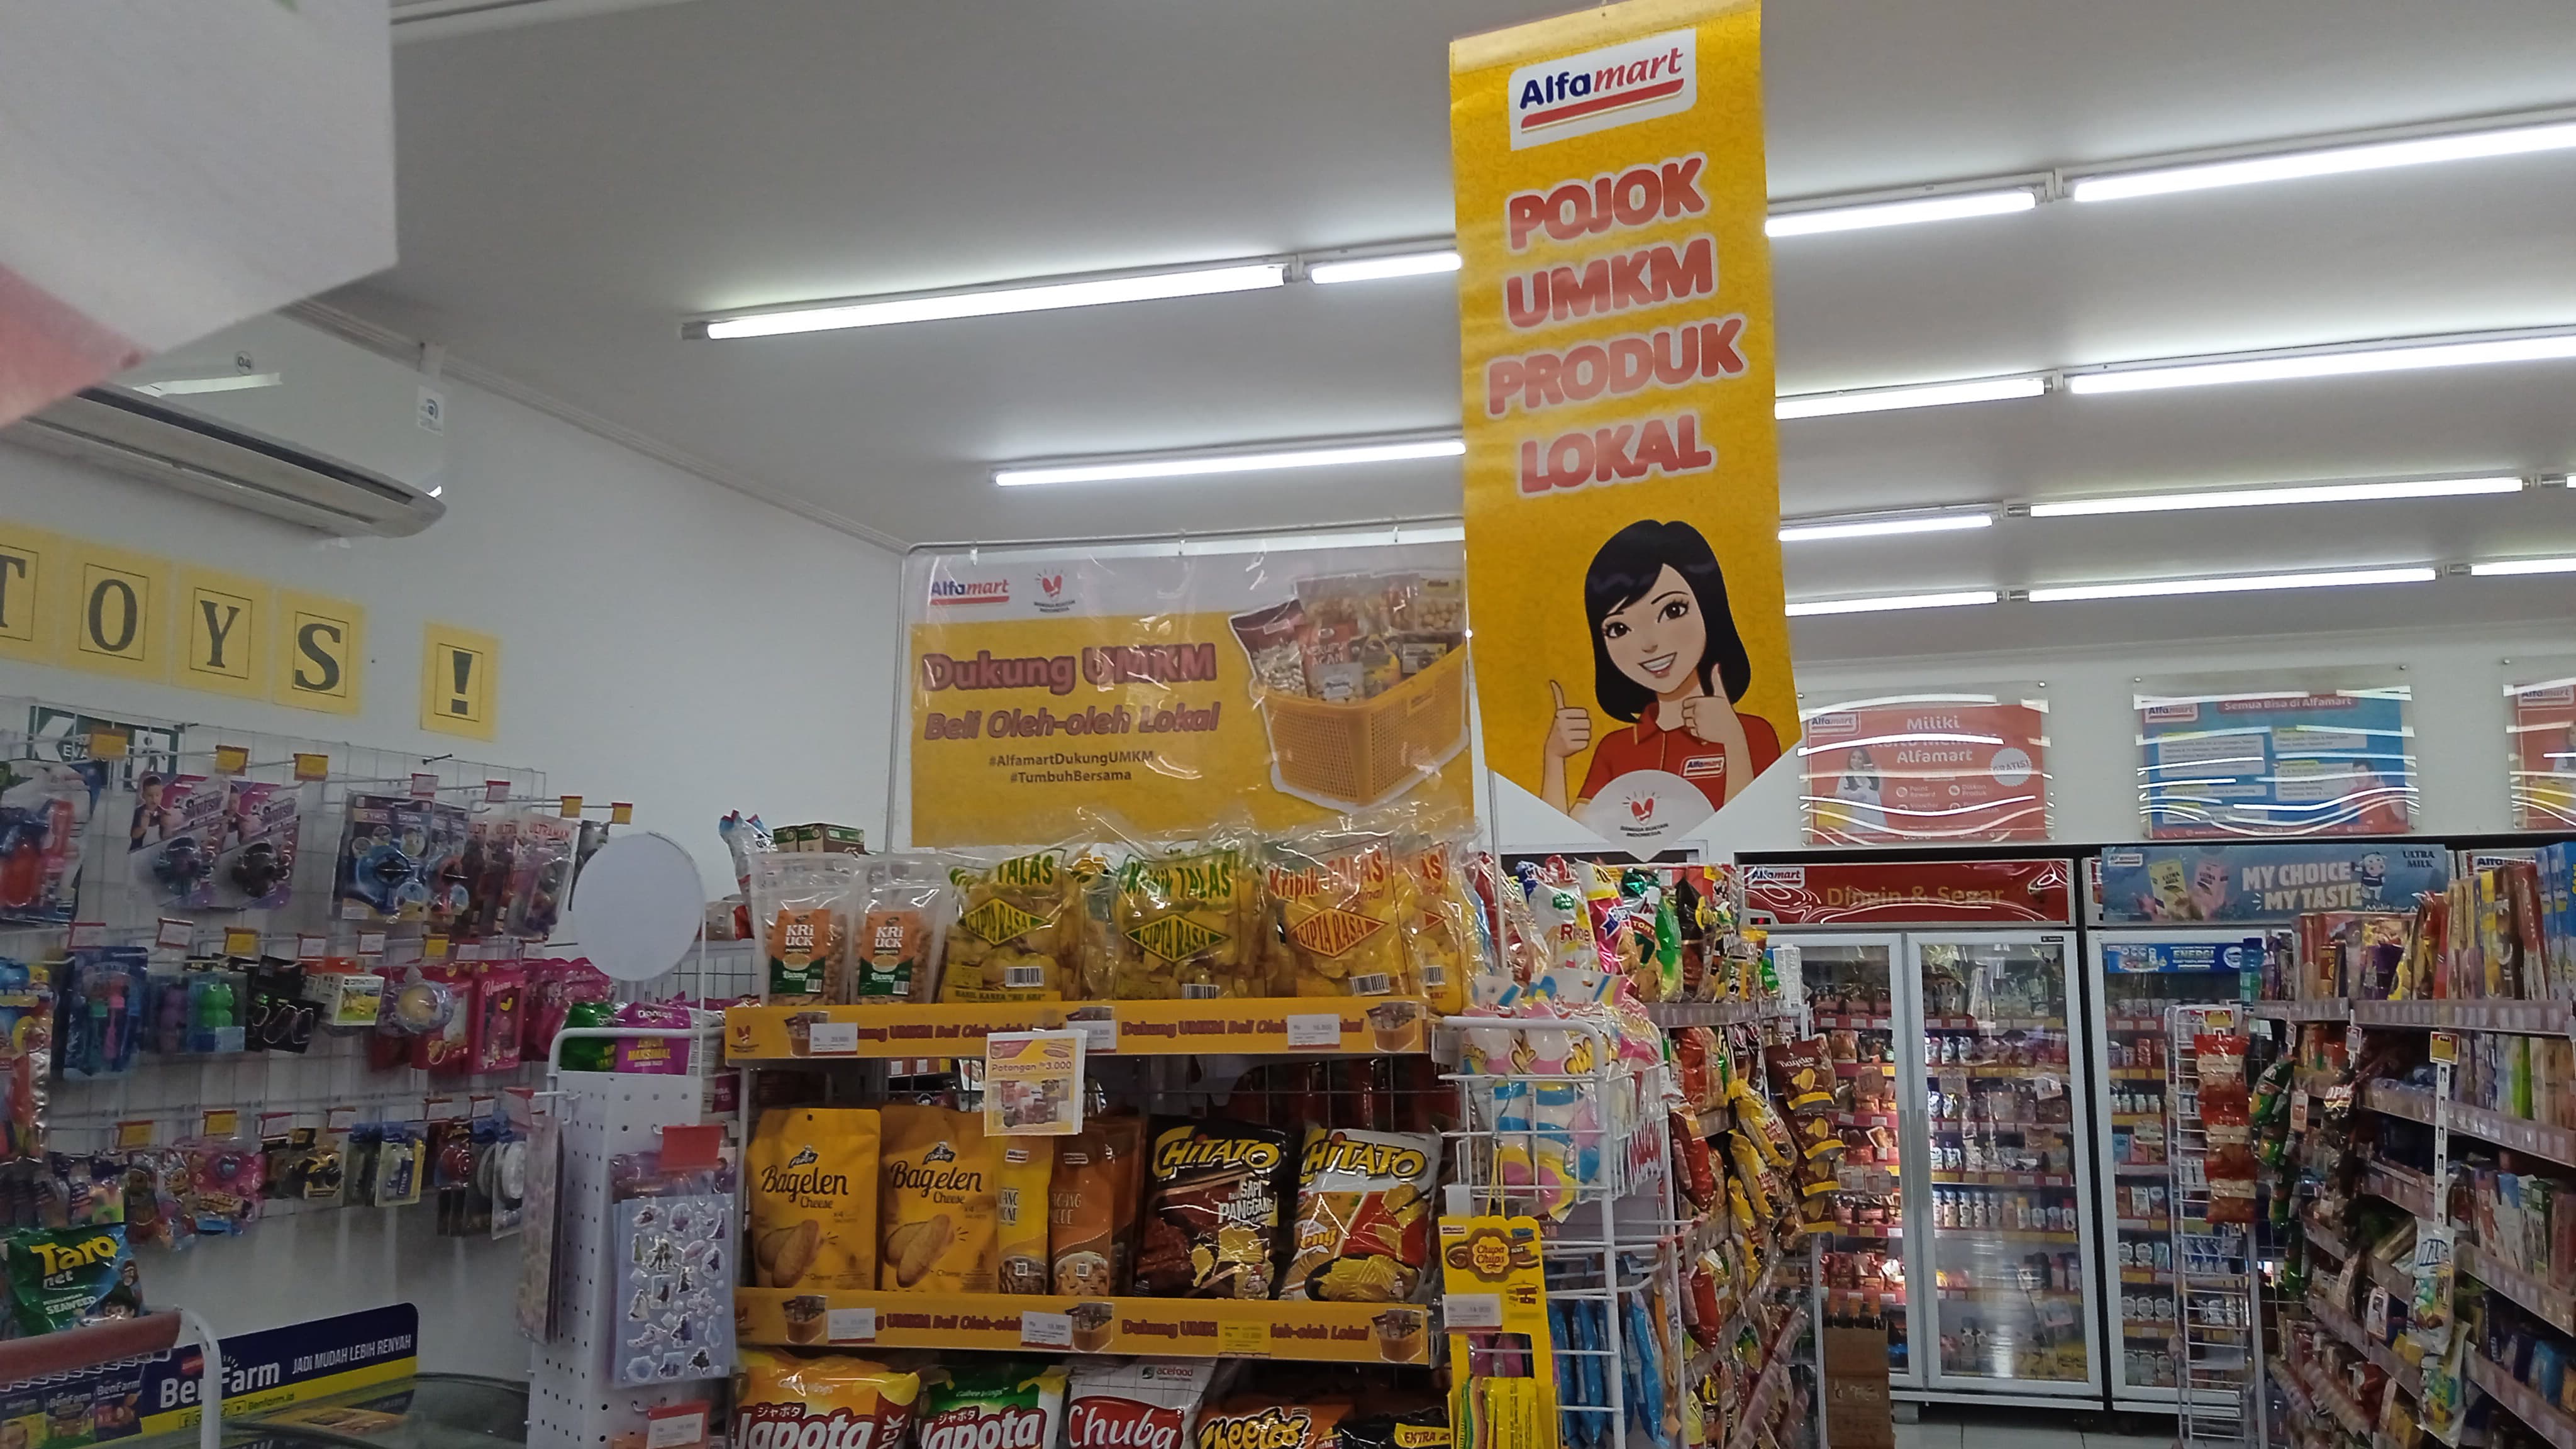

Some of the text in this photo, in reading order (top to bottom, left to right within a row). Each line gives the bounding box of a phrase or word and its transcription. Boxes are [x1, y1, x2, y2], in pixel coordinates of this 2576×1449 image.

[1519, 47, 1684, 109] Alfamart
[1508, 157, 1707, 250] POJOK
[1506, 239, 1714, 328] UMKM
[1487, 319, 1745, 415] PRODUK
[1520, 414, 1713, 494] LOKAL
[931, 579, 1009, 596] Alfamart
[922, 643, 1217, 696] Dukung UMKM
[2224, 696, 2353, 711] Semua Bisa di Alfamart
[924, 701, 1221, 740] Beli Oleh-oleh Lokal
[1811, 716, 1853, 726] Alfamart
[1907, 716, 1960, 730] Miliki
[989, 751, 1154, 767] #AlfamartDukungUMKM
[1896, 750, 1974, 764] Alfamart
[1011, 770, 1132, 784] #TumbuhBersama
[2402, 850, 2435, 860] ULTRA
[2407, 858, 2433, 868] MILK
[997, 854, 1054, 886] TALAS
[1175, 862, 1232, 899] TALAS
[2242, 862, 2352, 891] MY CHOICE
[1269, 867, 1320, 903] Kripik
[2264, 883, 2363, 911] MY TASTE
[1175, 917, 1206, 957] RASA
[1298, 913, 1366, 953] CIPTA RASA
[760, 1165, 848, 1204] Bagelen
[890, 1161, 982, 1197] Bagelen
[1241, 1180, 1262, 1199] SAPI
[800, 1196, 834, 1209] Cheese
[933, 1191, 965, 1206] Cheese
[1218, 1197, 1274, 1224] PANGGANG
[30, 1235, 118, 1277] Taro
[1476, 1254, 1505, 1264] Chups
[1477, 1245, 1506, 1256] Chupa
[42, 1270, 74, 1289] net
[45, 1296, 96, 1315] SEAWEED
[292, 1333, 412, 1376] JADI MUDAH LEBIH RENYAH
[1156, 1367, 1194, 1377] acefood
[1068, 1404, 1176, 1449] Chuba
